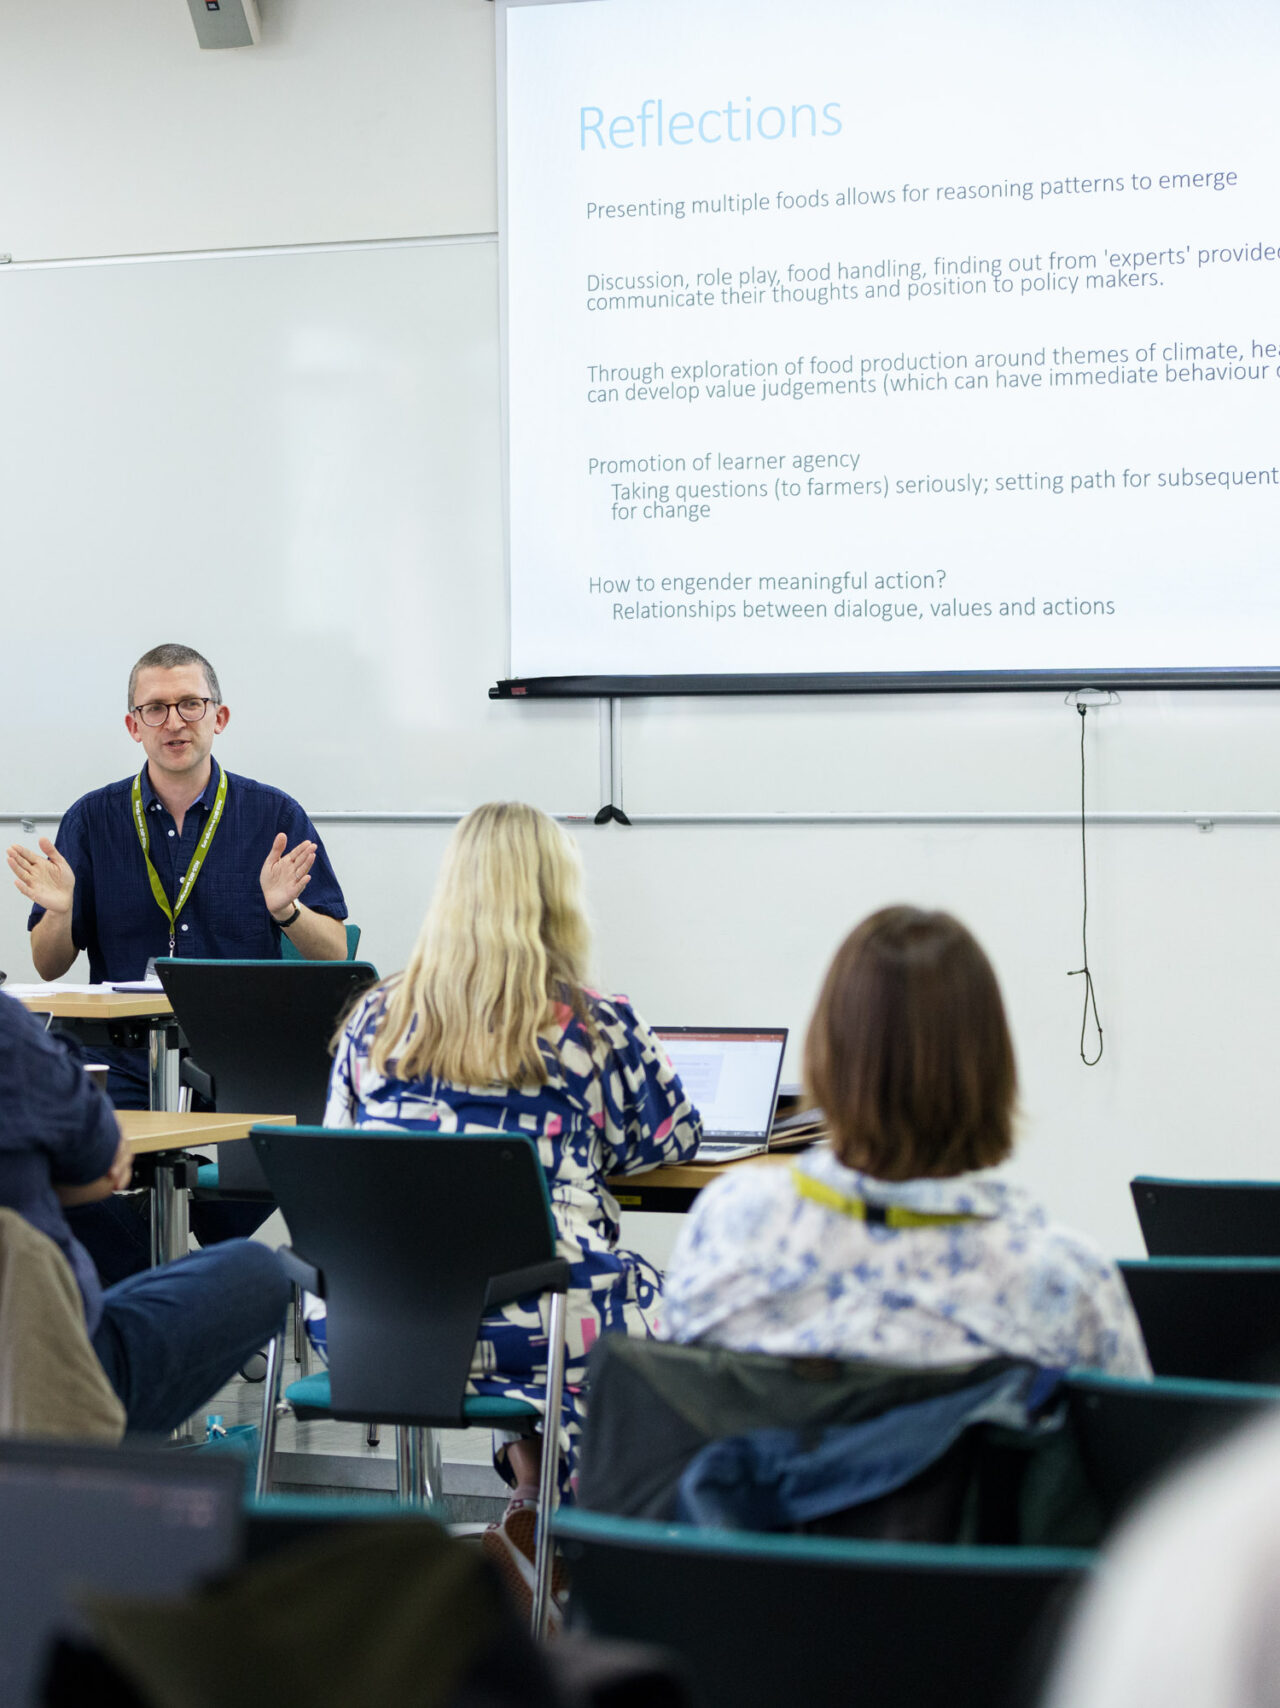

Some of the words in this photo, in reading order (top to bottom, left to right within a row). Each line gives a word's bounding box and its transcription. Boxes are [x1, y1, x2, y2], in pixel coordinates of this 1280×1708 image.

[579, 95, 844, 151] Reflections
[586, 198, 686, 220] Presenting
[692, 193, 770, 216] multiple
[776, 189, 829, 209] foods
[835, 187, 896, 207] allows
[902, 184, 930, 202] for
[936, 179, 1034, 201] reasoning
[1040, 175, 1125, 200] patterns
[1132, 173, 1153, 190] to
[1158, 170, 1238, 191] emerge
[587, 270, 689, 292] Discussion,
[696, 267, 732, 286] role
[739, 266, 781, 288] play,
[787, 262, 831, 282] food
[837, 259, 926, 279] handling,
[934, 256, 1002, 277] finding
[1009, 254, 1042, 272] out
[1049, 251, 1097, 270] from
[1104, 245, 1190, 270] 'experts'
[1198, 242, 1280, 268] provide
[587, 288, 715, 311] communicate
[721, 286, 766, 305] their
[773, 282, 859, 306] thoughts
[865, 279, 901, 299] and
[908, 274, 987, 300] position
[994, 274, 1014, 292] to
[1021, 272, 1079, 296] policy
[1086, 269, 1164, 289] makers.
[587, 362, 664, 384] Through
[671, 358, 779, 380] exploration
[784, 356, 804, 375] of
[809, 354, 853, 374] food
[860, 352, 967, 373] production
[974, 348, 1045, 369] around
[1053, 346, 1129, 366] themes
[1135, 343, 1157, 362] of
[1162, 341, 1244, 361] climate,
[587, 386, 619, 403] can
[625, 381, 700, 403] develop
[706, 379, 756, 399] value
[761, 377, 877, 401] judgements
[883, 370, 948, 396] (which
[954, 373, 988, 390] can
[996, 370, 1042, 389] have
[1049, 366, 1158, 387] immediate
[1165, 363, 1270, 383] behaviour
[588, 455, 686, 475] Promotion
[692, 453, 712, 472] of
[718, 452, 786, 471] learner
[792, 452, 861, 473] agency
[611, 482, 669, 503] Taking
[676, 480, 768, 502] questions
[774, 478, 802, 501] (to
[807, 475, 889, 498] farmers)
[895, 473, 988, 496] seriously;
[995, 472, 1064, 495] setting
[1070, 469, 1115, 493] path
[1122, 469, 1151, 488] for
[1158, 466, 1279, 489] subsequent
[611, 502, 637, 520] for
[643, 501, 711, 522] change
[588, 576, 631, 594] How
[637, 575, 655, 592] to
[661, 572, 752, 595] engender
[758, 571, 867, 593] meaningful
[874, 570, 946, 590] action?
[613, 600, 737, 621] Relationships
[743, 600, 827, 619] between
[833, 599, 924, 622] dialogue,
[930, 597, 993, 617] values
[999, 597, 1036, 616] and
[1043, 597, 1115, 616] actions
